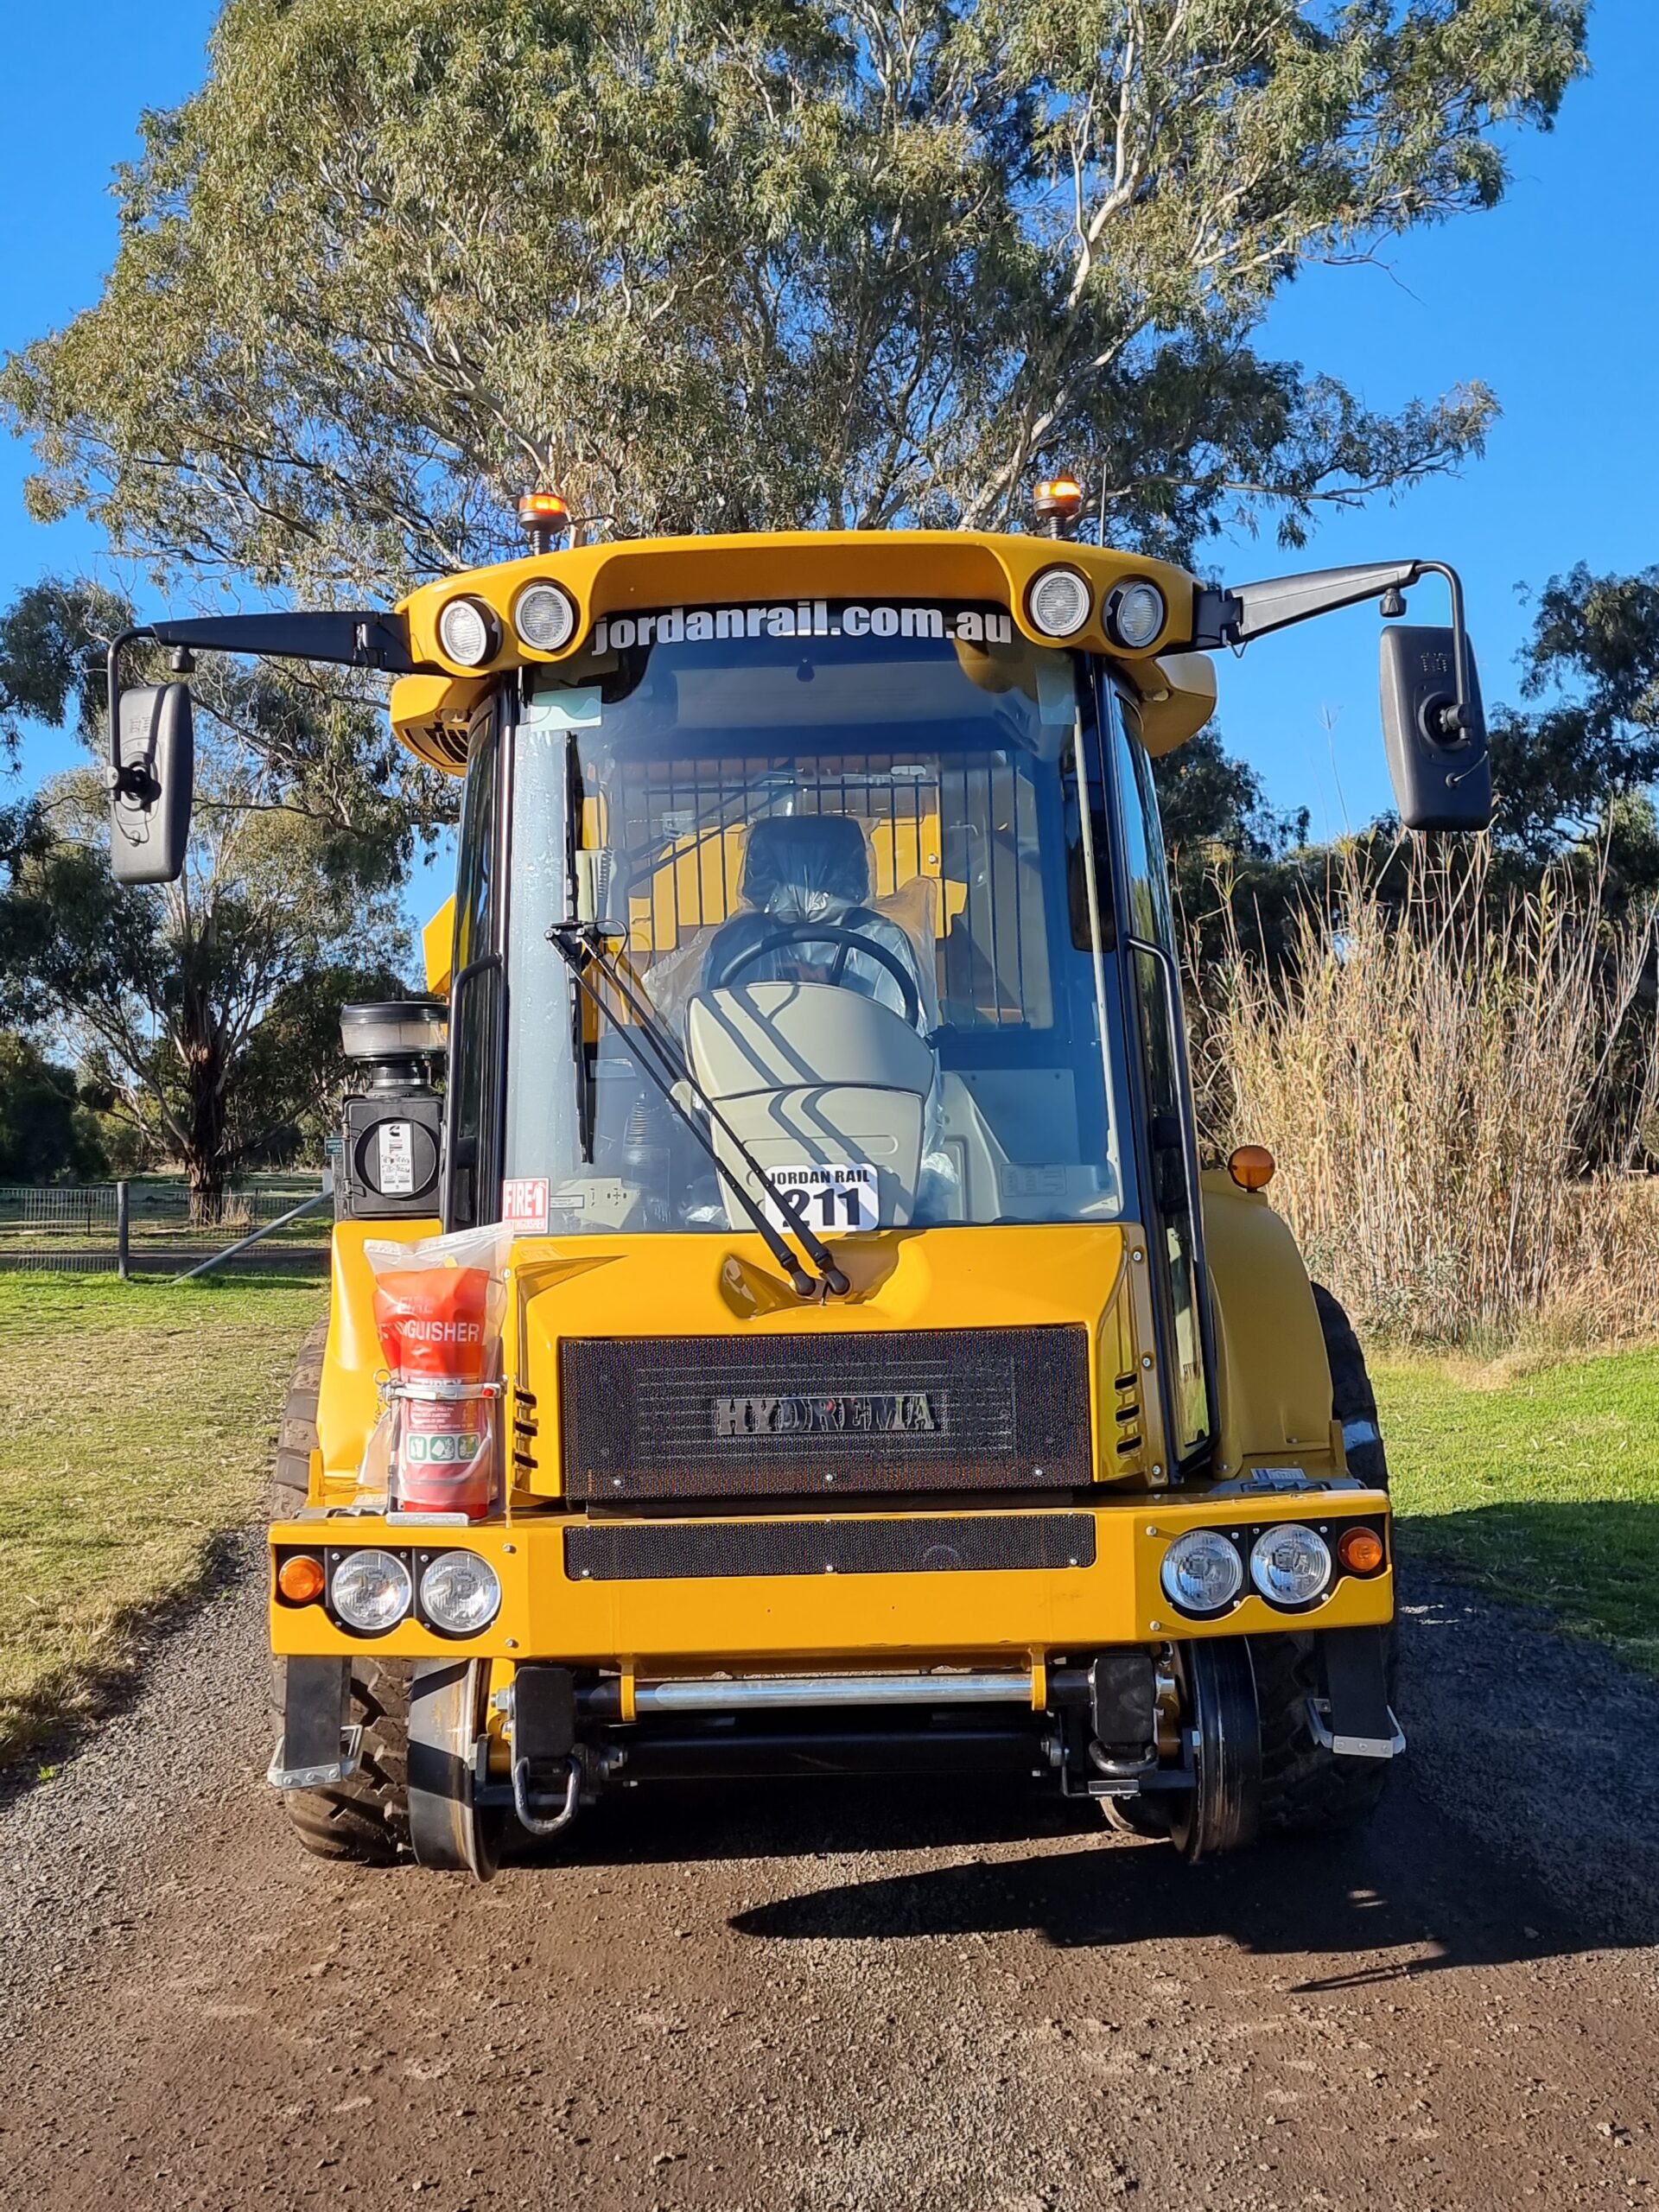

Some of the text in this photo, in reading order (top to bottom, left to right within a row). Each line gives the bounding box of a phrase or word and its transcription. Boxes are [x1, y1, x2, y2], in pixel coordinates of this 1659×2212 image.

[591, 601, 1014, 656] jordanrail.com.au
[771, 1169, 870, 1185] JORDAN RAIL
[505, 1181, 533, 1217] FIRE
[781, 1187, 861, 1228] 211
[716, 1393, 936, 1436] HYDREMA
